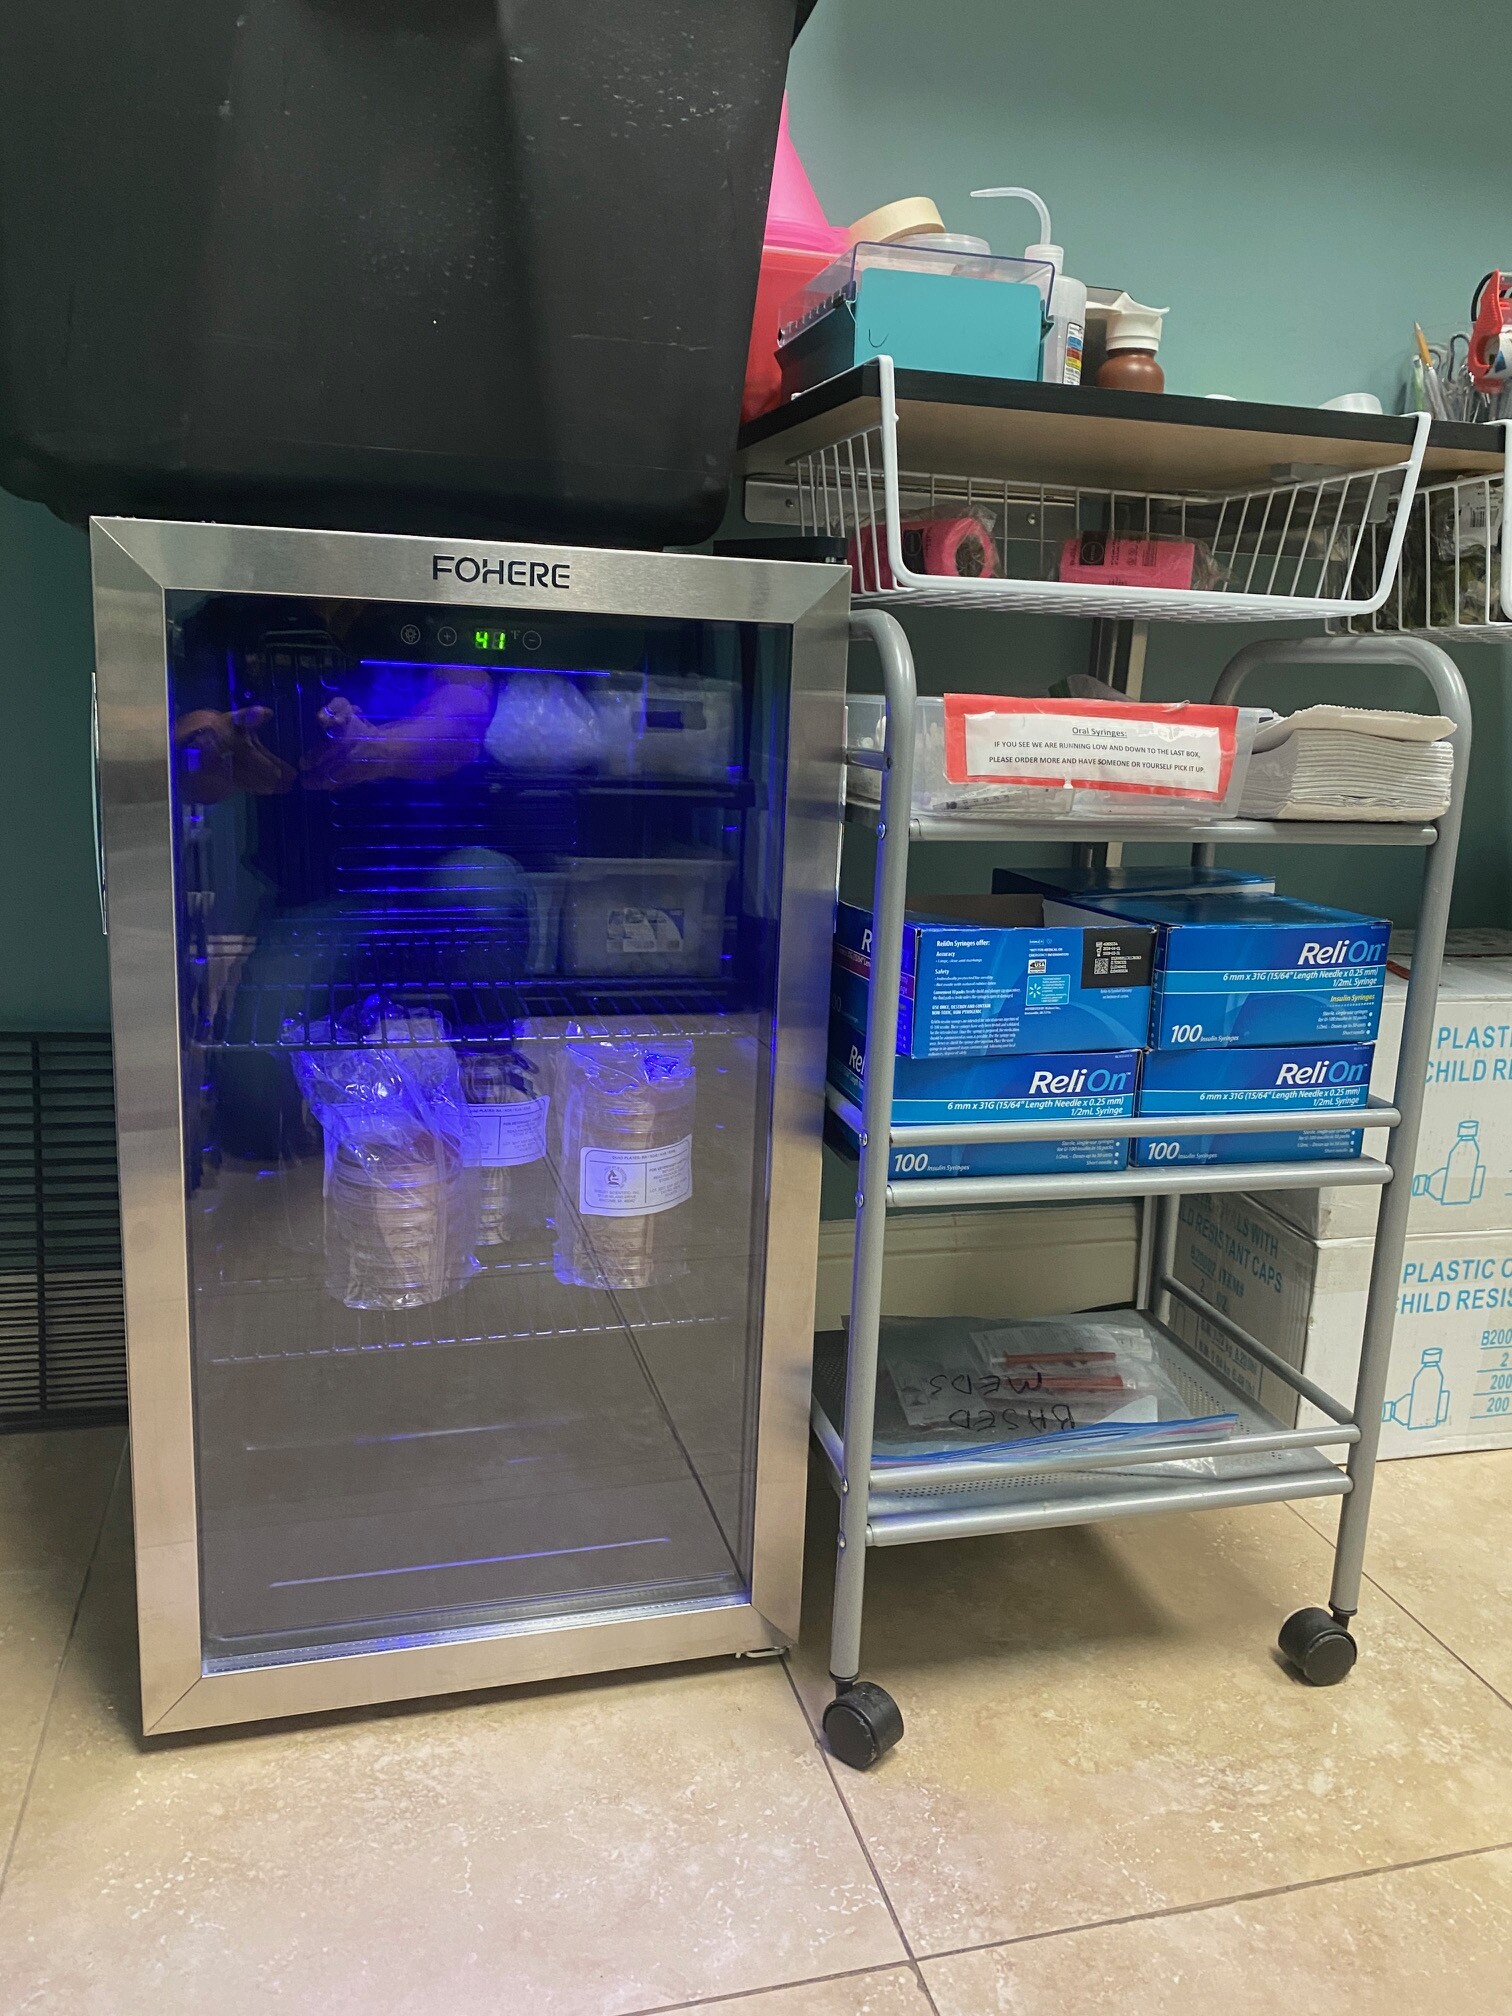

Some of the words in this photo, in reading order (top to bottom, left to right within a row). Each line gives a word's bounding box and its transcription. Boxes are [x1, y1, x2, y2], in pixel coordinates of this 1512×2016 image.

[432, 554, 570, 589] FOHERE
[475, 631, 506, 650] 41
[1072, 727, 1089, 735] Oral
[1091, 728, 1127, 738] Syringes:
[1059, 742, 1091, 750] RUNNING
[1186, 751, 1201, 759] BOX,
[1014, 756, 1038, 764] ORDER
[1097, 759, 1130, 767] SOMEONE
[1142, 761, 1173, 770] YOURSELF
[1174, 764, 1188, 772] PICK
[954, 940, 975, 948] Syringes
[1297, 940, 1382, 965] ReliOn
[1251, 972, 1267, 980] 31G
[1293, 970, 1318, 980] Length
[1319, 970, 1343, 978] Needle
[1349, 969, 1364, 977] 0.25
[1363, 967, 1379, 976] mm)
[1332, 979, 1352, 987] 1/2mL
[1353, 977, 1377, 987] Syringe
[1351, 994, 1375, 1002] Syringes
[1170, 1025, 1203, 1043] 100
[1217, 1035, 1239, 1043] Syringes
[1029, 1068, 1126, 1094] ReliOn
[1275, 1060, 1364, 1085] ReliOn
[1200, 1092, 1206, 1100] 6
[1229, 1092, 1244, 1100] 31G
[1272, 1090, 1298, 1100] Length
[1298, 1089, 1324, 1098] Needle
[1330, 1088, 1344, 1096] 0.25
[1344, 1087, 1361, 1096] mm)
[1313, 1097, 1334, 1106] 1/2mL
[1335, 1096, 1359, 1106] Syringe
[947, 1102, 954, 1110] 6
[979, 1101, 995, 1110] 31G
[1025, 1099, 1053, 1110] Length
[1054, 1099, 1082, 1107] Needle
[1089, 1098, 1106, 1106] 0.25
[1106, 1096, 1124, 1106] mm)
[1071, 1107, 1094, 1116] 1/2mL
[1095, 1106, 1123, 1117] Syringe
[1148, 1142, 1180, 1160] 100
[1196, 1151, 1218, 1160] Syringes
[894, 1153, 929, 1172] 100
[927, 1163, 946, 1171] Insulin
[946, 1163, 970, 1172] Syringes
[1195, 1213, 1251, 1269] RESISTANT
[1252, 1255, 1282, 1293] CAPS
[1403, 1259, 1496, 1284] PLASTIC
[1395, 1291, 1450, 1314] HILD
[1500, 1353, 1508, 1367] 2
[929, 1372, 1043, 1396] MEDS
[1487, 1397, 1509, 1412] 200
